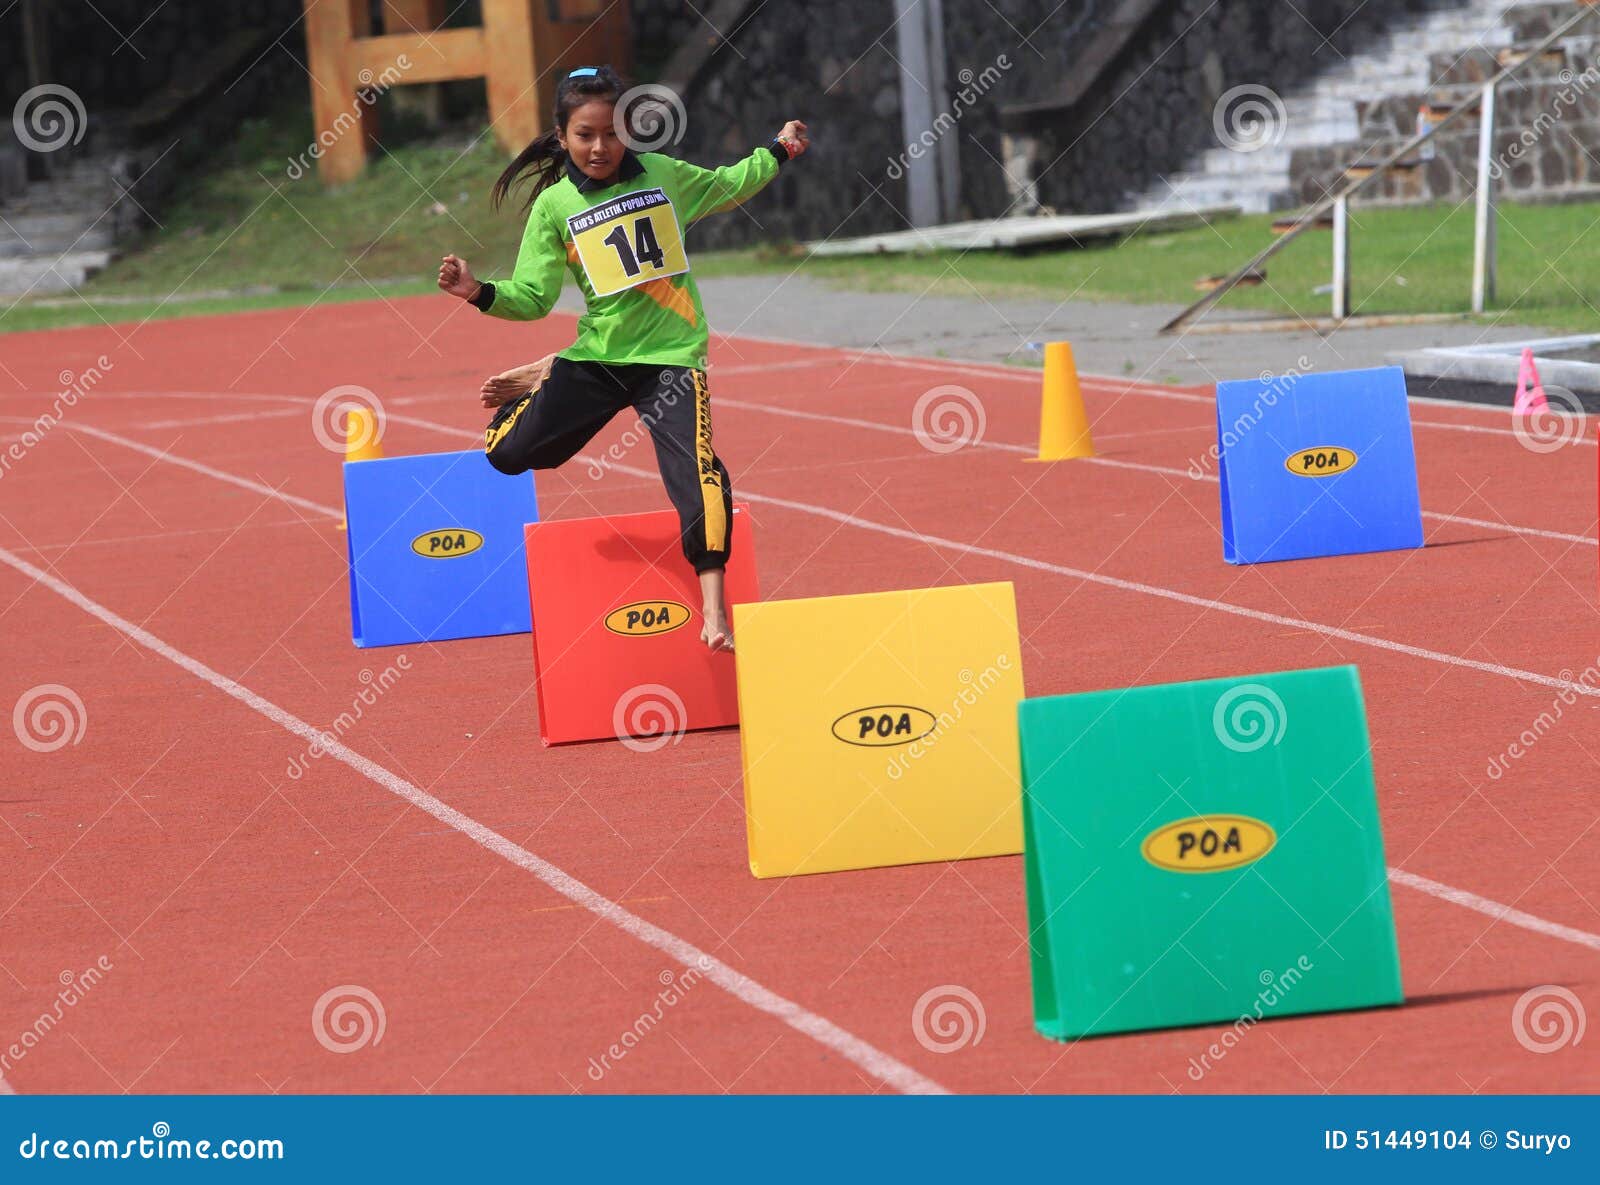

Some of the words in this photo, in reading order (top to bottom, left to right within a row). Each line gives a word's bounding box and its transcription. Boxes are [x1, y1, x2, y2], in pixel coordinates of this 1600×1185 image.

[573, 216, 595, 231] KID'S
[594, 203, 624, 223] ATLETIK
[603, 216, 664, 278] 14
[1303, 452, 1339, 470] POA
[430, 534, 466, 552] POA
[626, 607, 670, 629] POA
[858, 712, 912, 739] POA
[1177, 826, 1242, 860] POA
